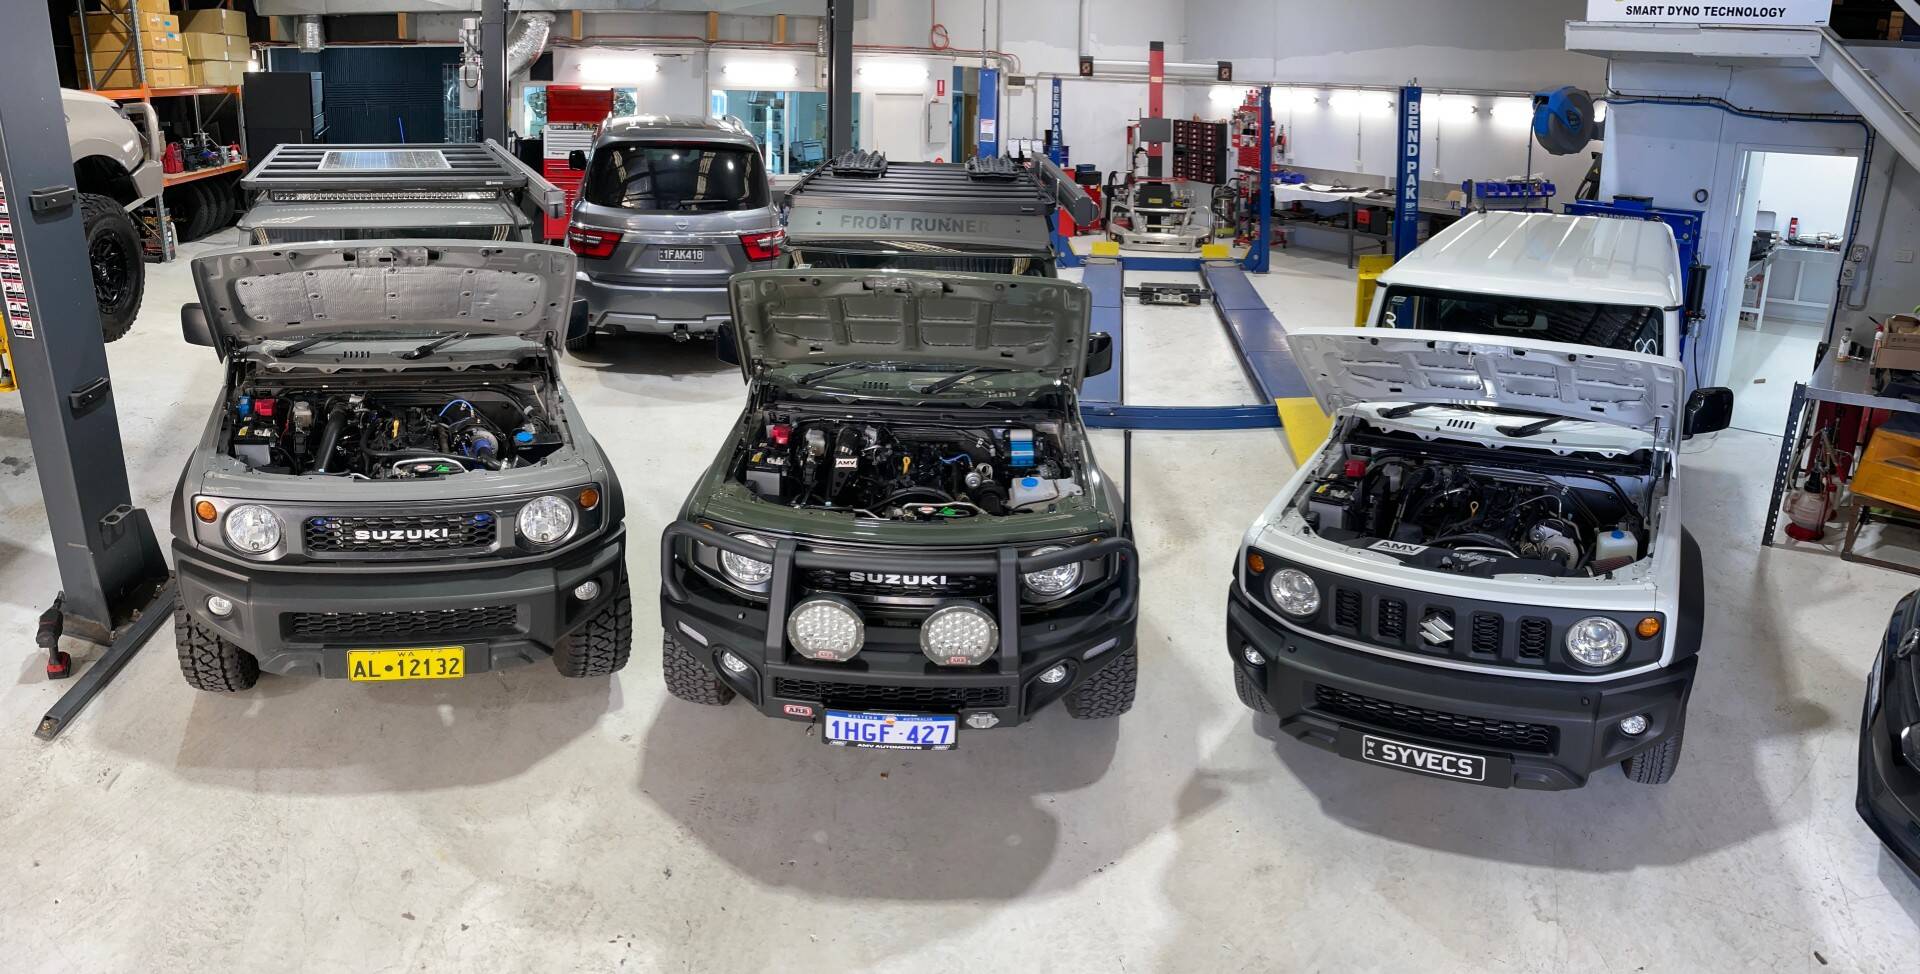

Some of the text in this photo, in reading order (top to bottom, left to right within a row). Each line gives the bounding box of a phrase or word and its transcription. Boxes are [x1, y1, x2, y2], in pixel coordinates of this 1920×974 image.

[1626, 5, 1786, 18] SMART DYNO TECHNOLOGY
[1407, 101, 1419, 157] BEND
[1405, 161, 1417, 200] PAK
[840, 214, 992, 234] FRONT RUNNER
[354, 528, 448, 540] SUZUKI
[1376, 541, 1420, 552] AMV
[849, 571, 947, 585] SUZUKI
[1382, 744, 1473, 776] SYVECS
